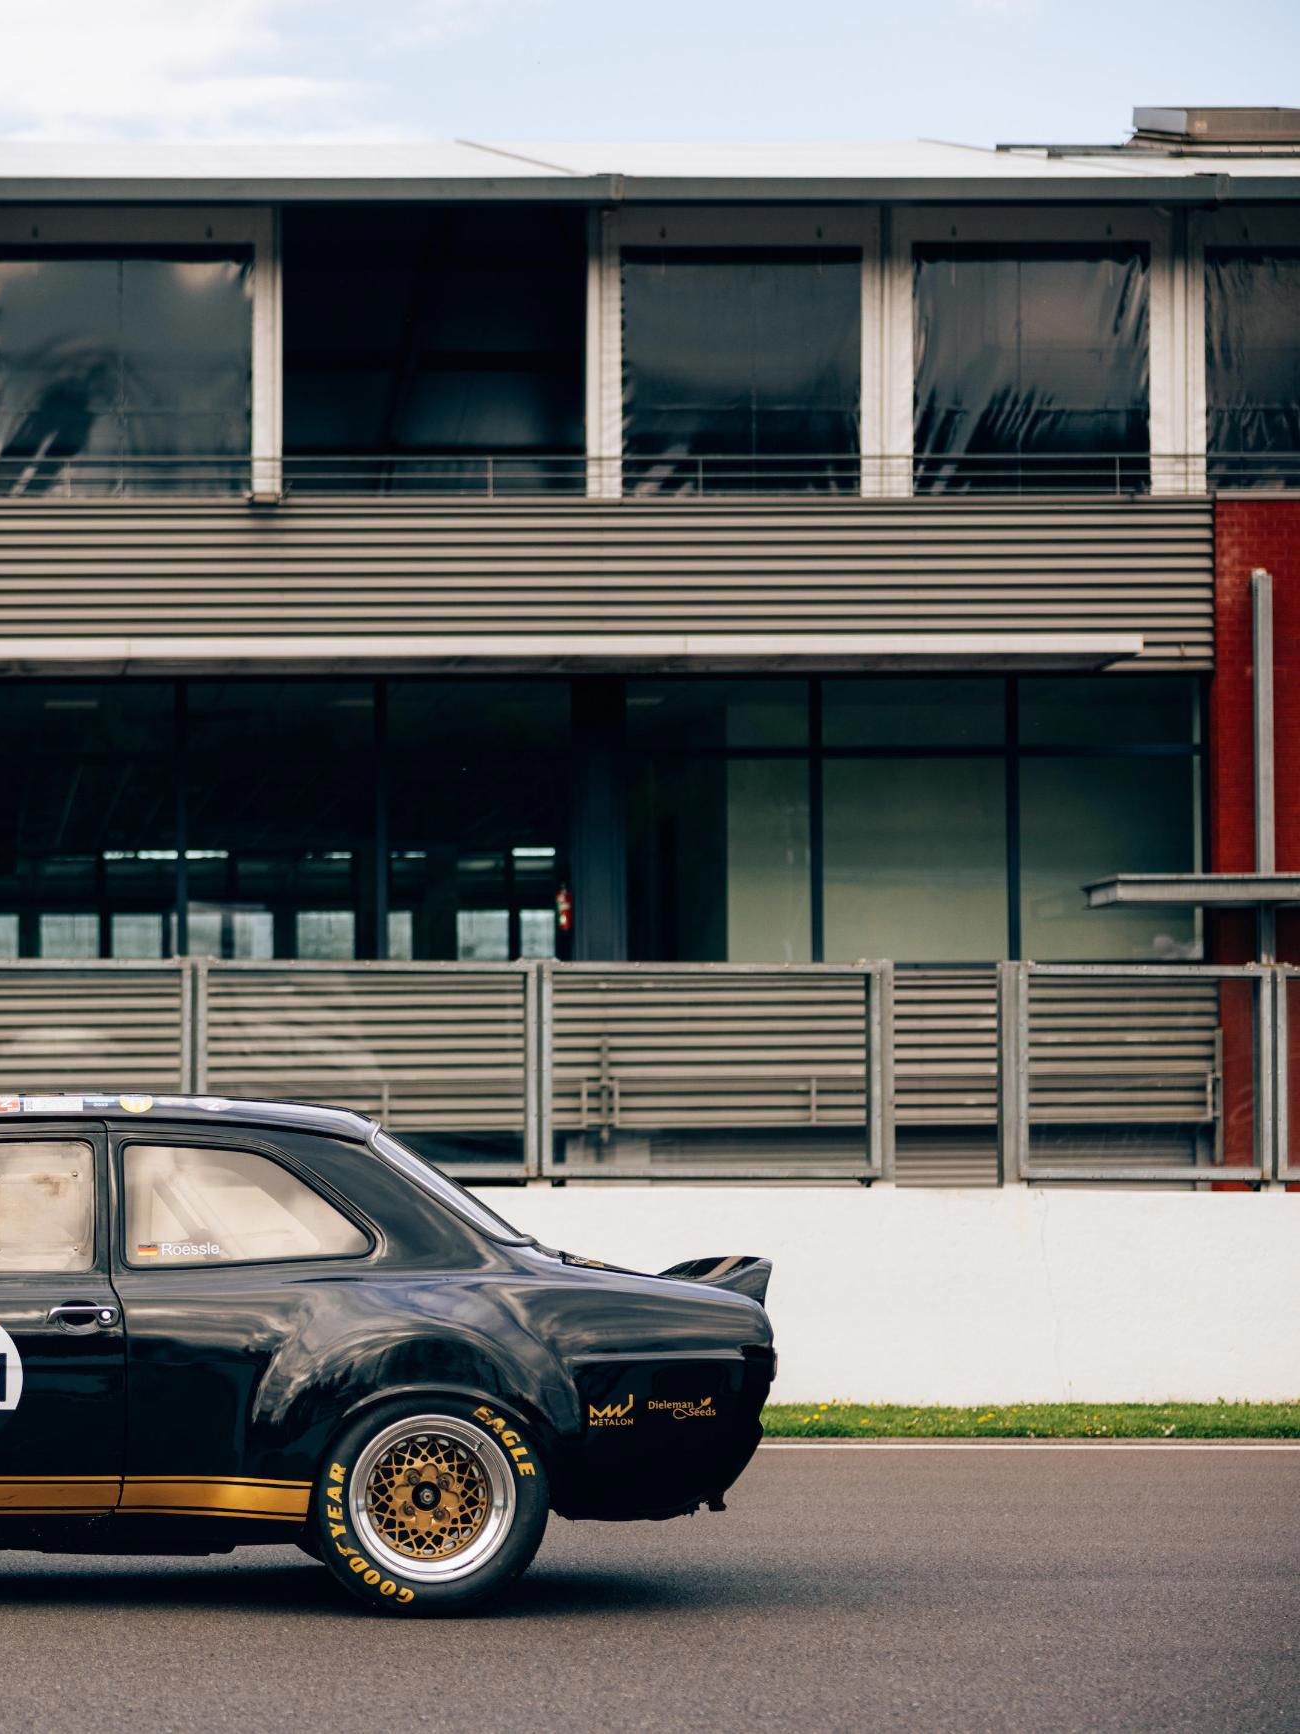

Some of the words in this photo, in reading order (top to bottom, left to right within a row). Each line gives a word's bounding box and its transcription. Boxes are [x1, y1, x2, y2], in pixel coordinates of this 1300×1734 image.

[161, 1241, 220, 1256] Roessle
[648, 1400, 694, 1410] Dieleman
[687, 1407, 717, 1417] Seeds
[589, 1418, 634, 1427] METALON
[472, 1405, 536, 1477] EAGLE
